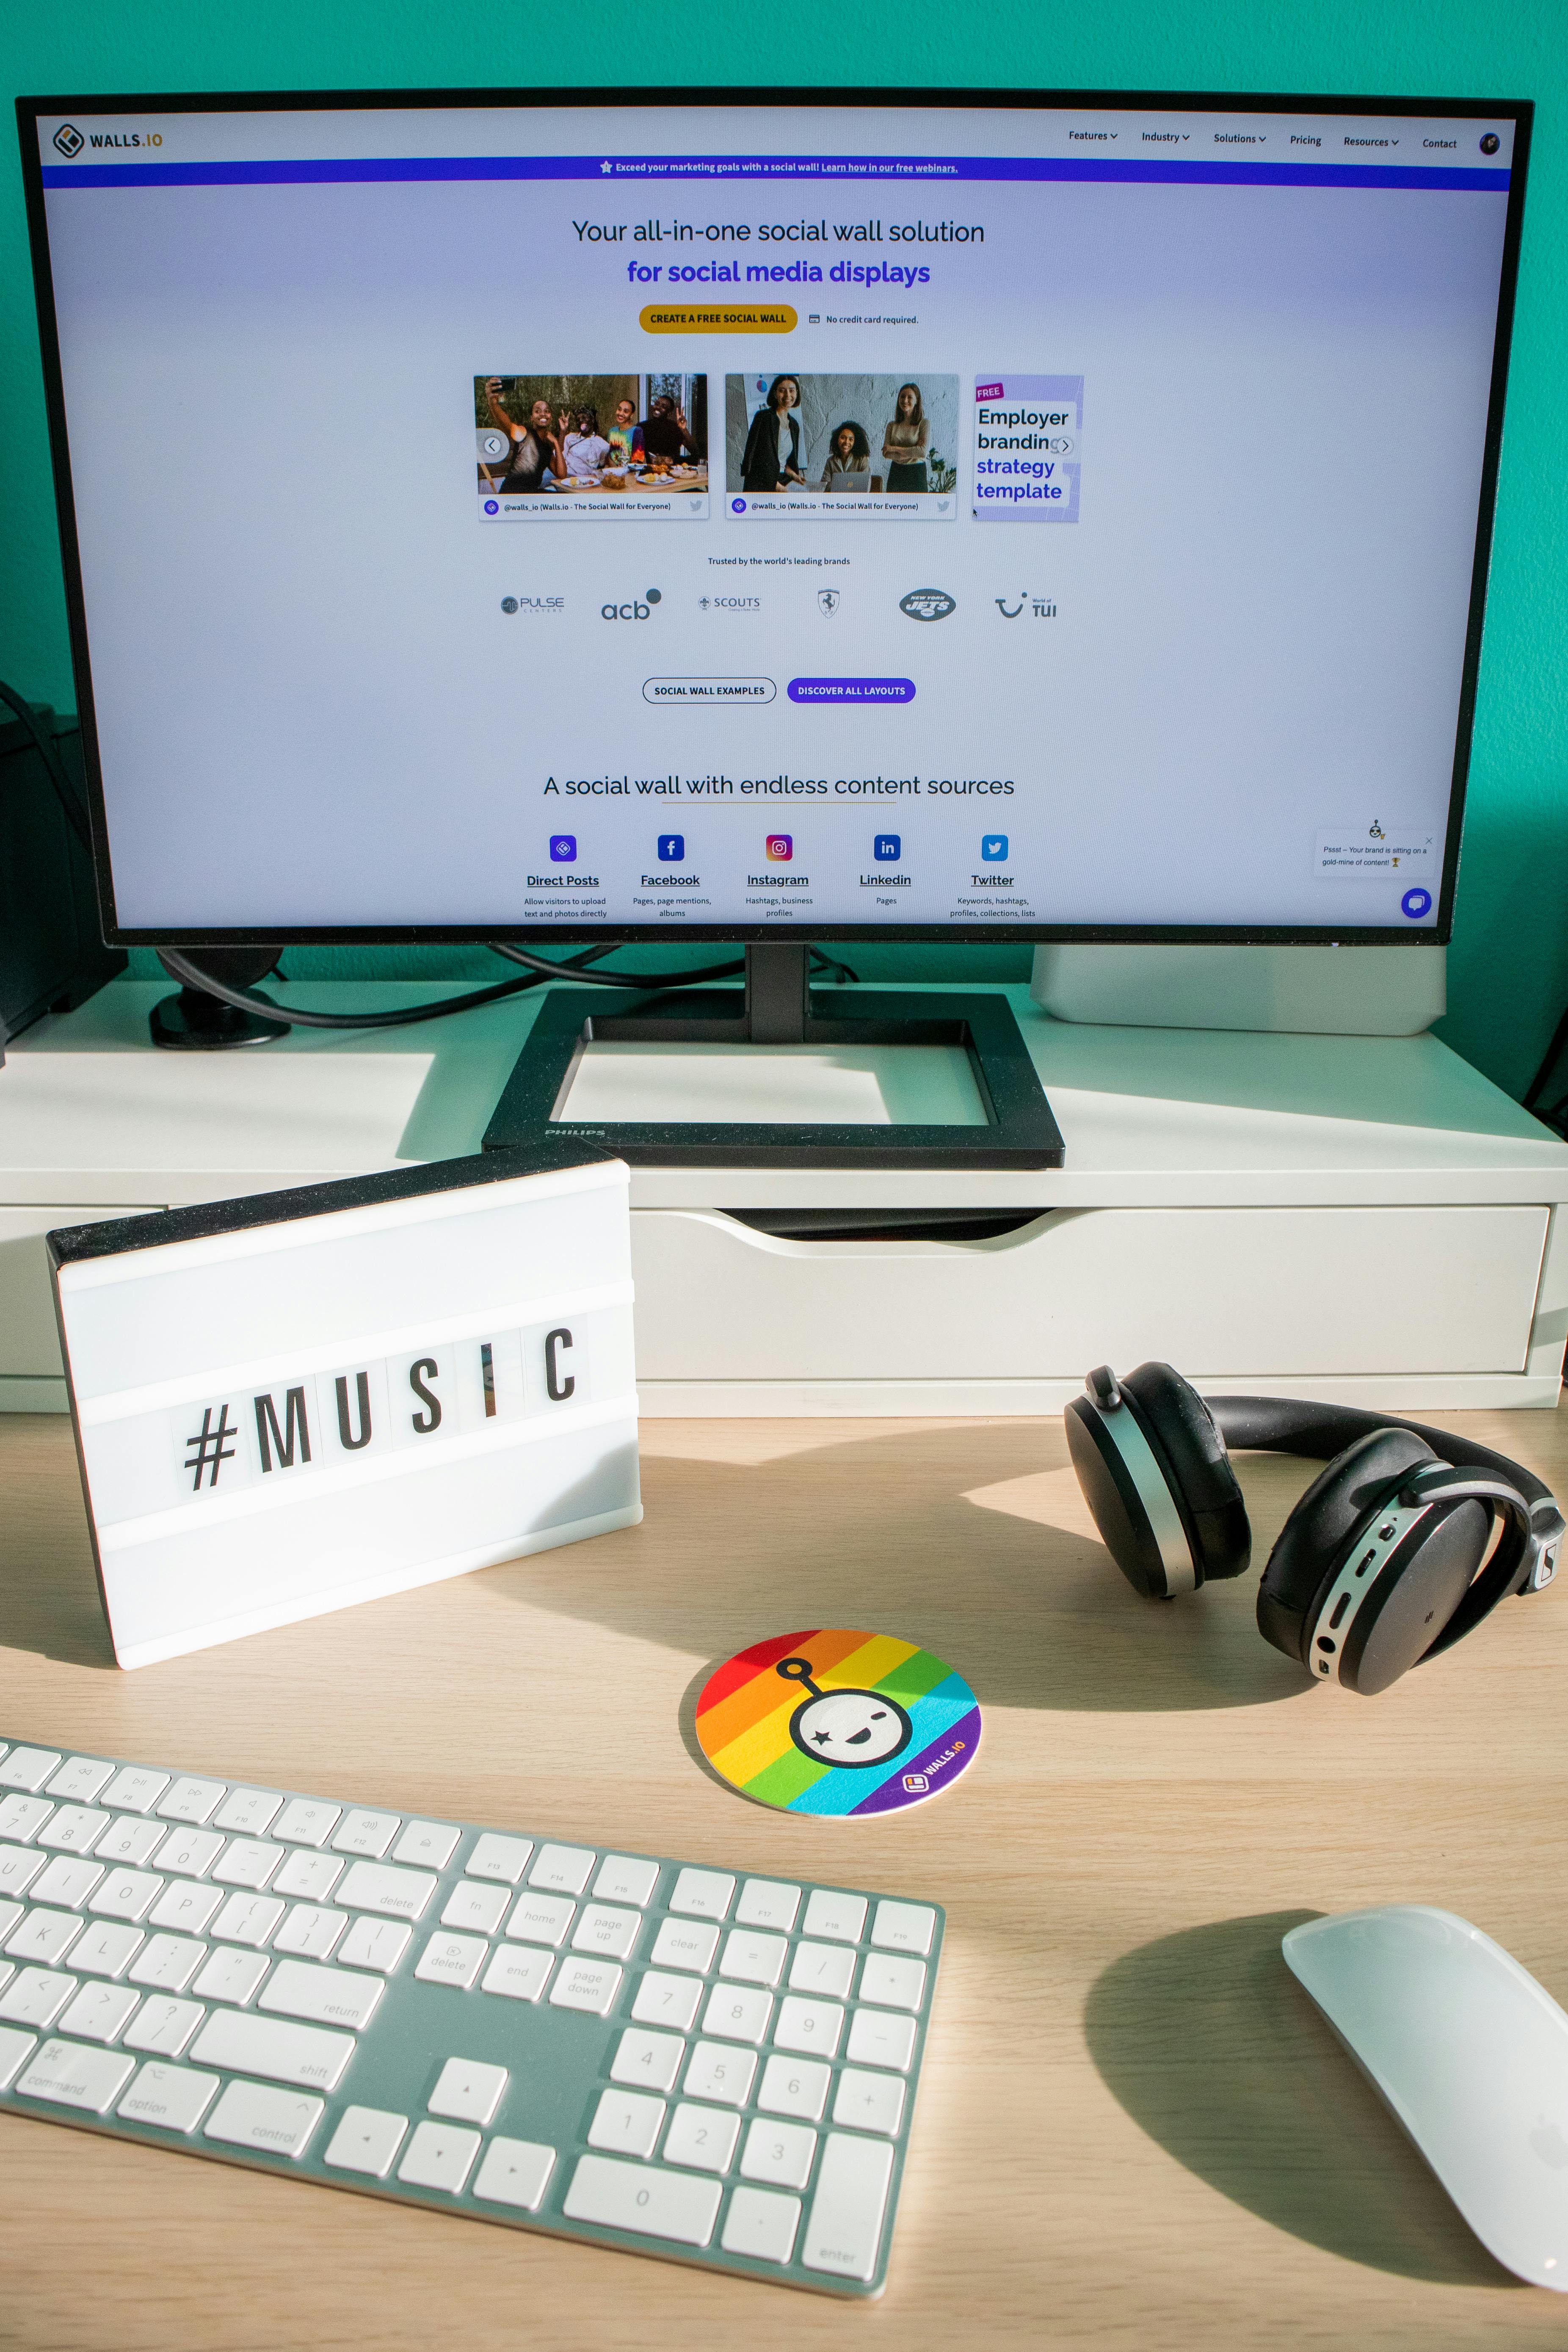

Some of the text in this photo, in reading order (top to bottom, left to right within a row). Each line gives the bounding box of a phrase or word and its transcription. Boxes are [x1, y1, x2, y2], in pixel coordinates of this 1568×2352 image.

[90, 134, 162, 147] WALLS.IO
[1069, 131, 1107, 141] Features
[1143, 133, 1179, 143] Industry
[1214, 134, 1256, 143] Solutions
[1291, 136, 1321, 146] Pricing
[1344, 137, 1389, 146] Resources
[1423, 139, 1457, 148] Contact
[616, 163, 646, 171] Exceed
[670, 163, 715, 173] marketing
[717, 163, 739, 173] goals
[742, 163, 761, 171] with
[771, 163, 795, 171] social
[798, 163, 819, 171] wall!
[822, 163, 846, 171] Learn
[848, 163, 866, 171] how
[915, 164, 958, 173] webinars.
[572, 219, 985, 242] Your all-in-one social wall solution
[627, 260, 930, 288] for social media displays
[651, 314, 786, 323] CREATE A FREE SOCIAL WALL
[883, 316, 919, 326] required.
[977, 387, 999, 398] FREE
[979, 409, 1068, 429] Employer
[977, 459, 1055, 478] strategy
[977, 483, 1062, 502] template
[540, 503, 569, 511] (Walls.io
[637, 503, 671, 511] Everyone)
[885, 503, 918, 511] Everyone)
[739, 558, 748, 566] by
[794, 558, 822, 566] leading
[521, 598, 564, 607] PULSE
[715, 598, 759, 607] SCOUTS
[906, 601, 949, 610] JETS
[601, 601, 650, 620] acb
[1033, 605, 1056, 616] TUI
[655, 687, 765, 695] SOCIAL WALL EXAMPLES
[798, 687, 905, 695] DISCOVER ALL LAYOUTS
[544, 776, 1014, 795] A social wall with endless content sources
[527, 876, 599, 886] Direct Posts
[641, 875, 700, 885] Facebook
[748, 875, 809, 887] Instagram
[860, 875, 911, 885] Linkedin
[972, 875, 1014, 885] Twitter
[581, 898, 606, 906] upload
[633, 898, 655, 906] Pages,
[996, 897, 1029, 906] hashtags,
[555, 910, 579, 919] photos
[580, 910, 607, 919] directly
[766, 910, 792, 918] profiles
[950, 910, 978, 918] profiles,
[184, 1328, 574, 1491] #MUSIC
[923, 1741, 965, 1775] WALLS.IO
[380, 1896, 413, 1909] delete
[470, 1901, 481, 1911] fn
[525, 1911, 555, 1924] home
[594, 1919, 622, 1930] page
[597, 1931, 611, 1941] up
[671, 1938, 699, 1950] clear
[431, 1957, 466, 1970] delete
[507, 1966, 529, 1977] end
[574, 1971, 602, 1984] page
[568, 1983, 599, 1996] down
[324, 2004, 359, 2018] return
[300, 2065, 327, 2078] shift
[28, 2076, 86, 2095] command
[129, 2098, 166, 2114] option
[252, 2126, 297, 2143] control
[820, 2248, 856, 2264] enter
